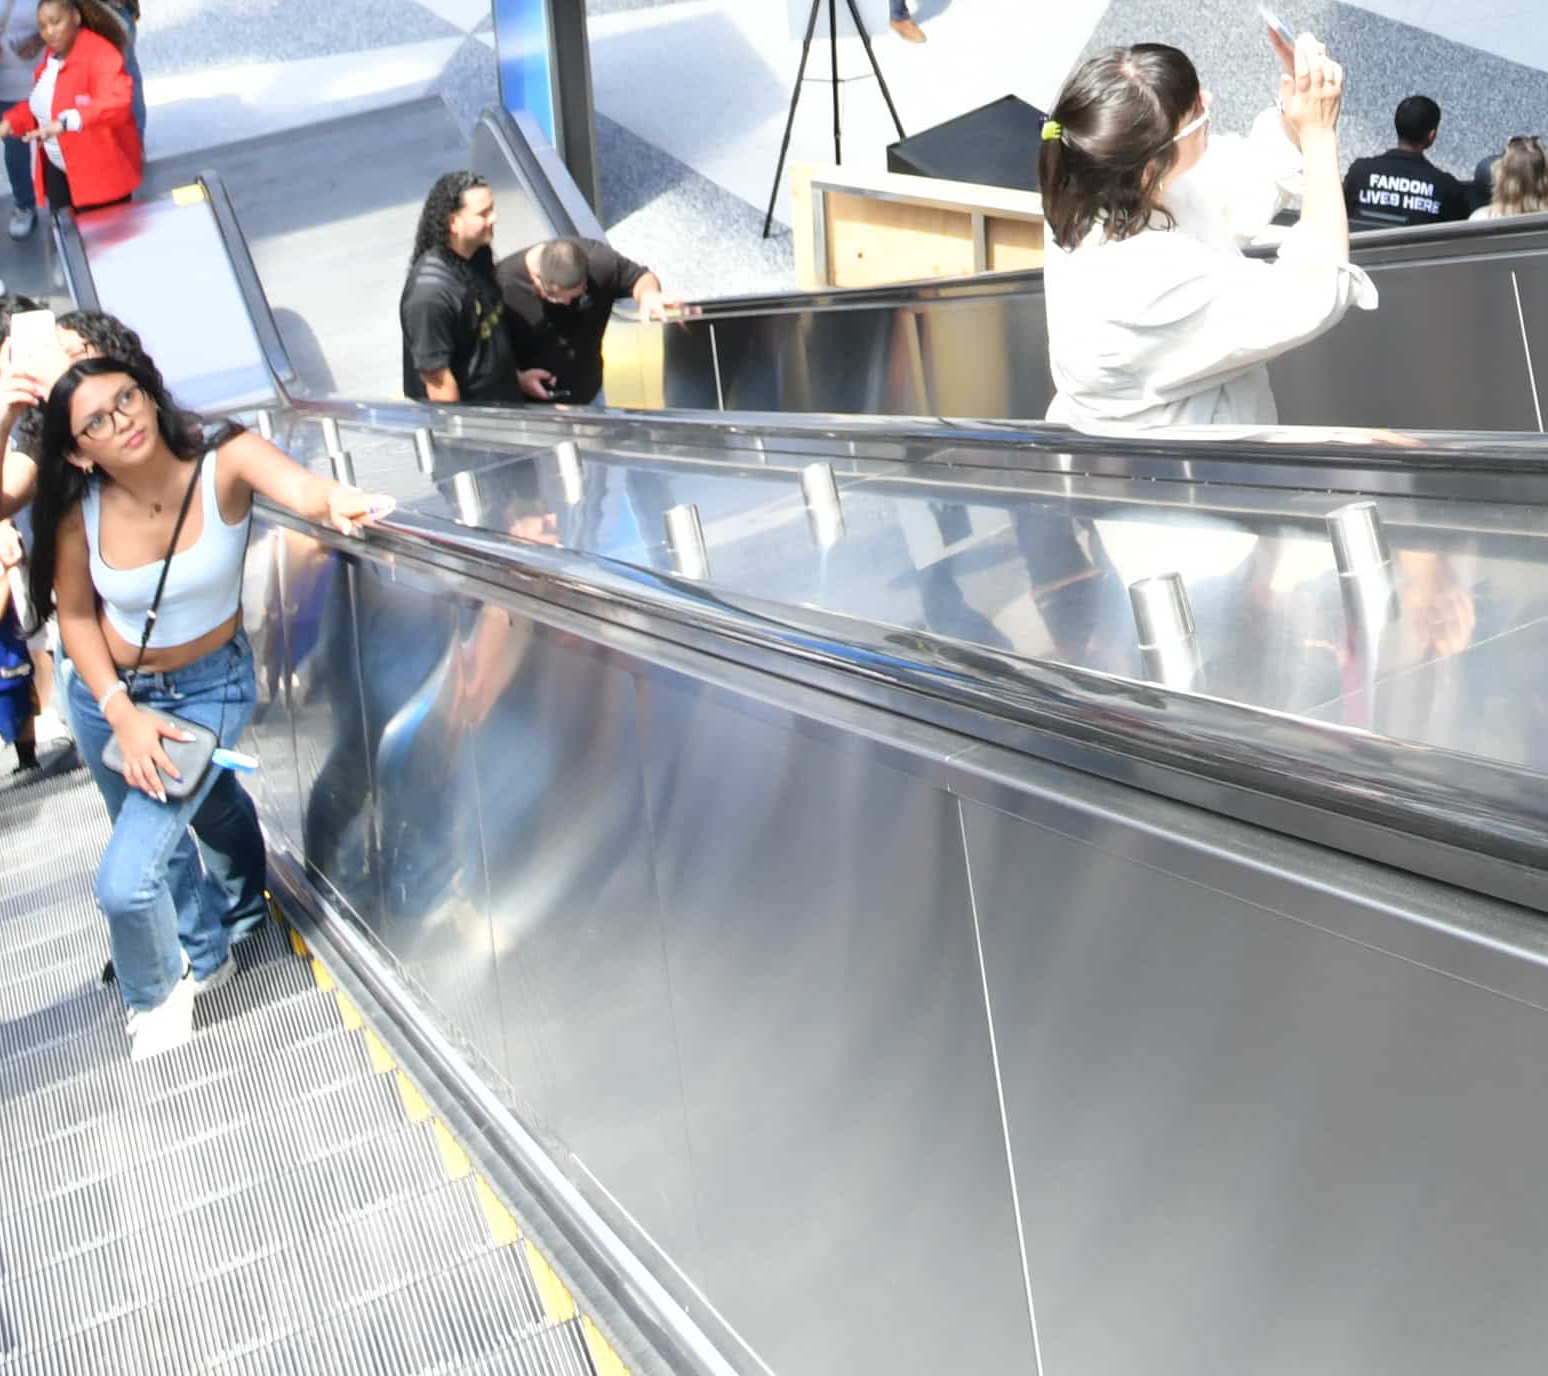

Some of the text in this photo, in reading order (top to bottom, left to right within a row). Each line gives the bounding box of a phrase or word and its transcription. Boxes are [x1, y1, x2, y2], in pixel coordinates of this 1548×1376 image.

[1369, 173, 1435, 197] FANDOM
[1359, 189, 1442, 215] LIVES HERE
